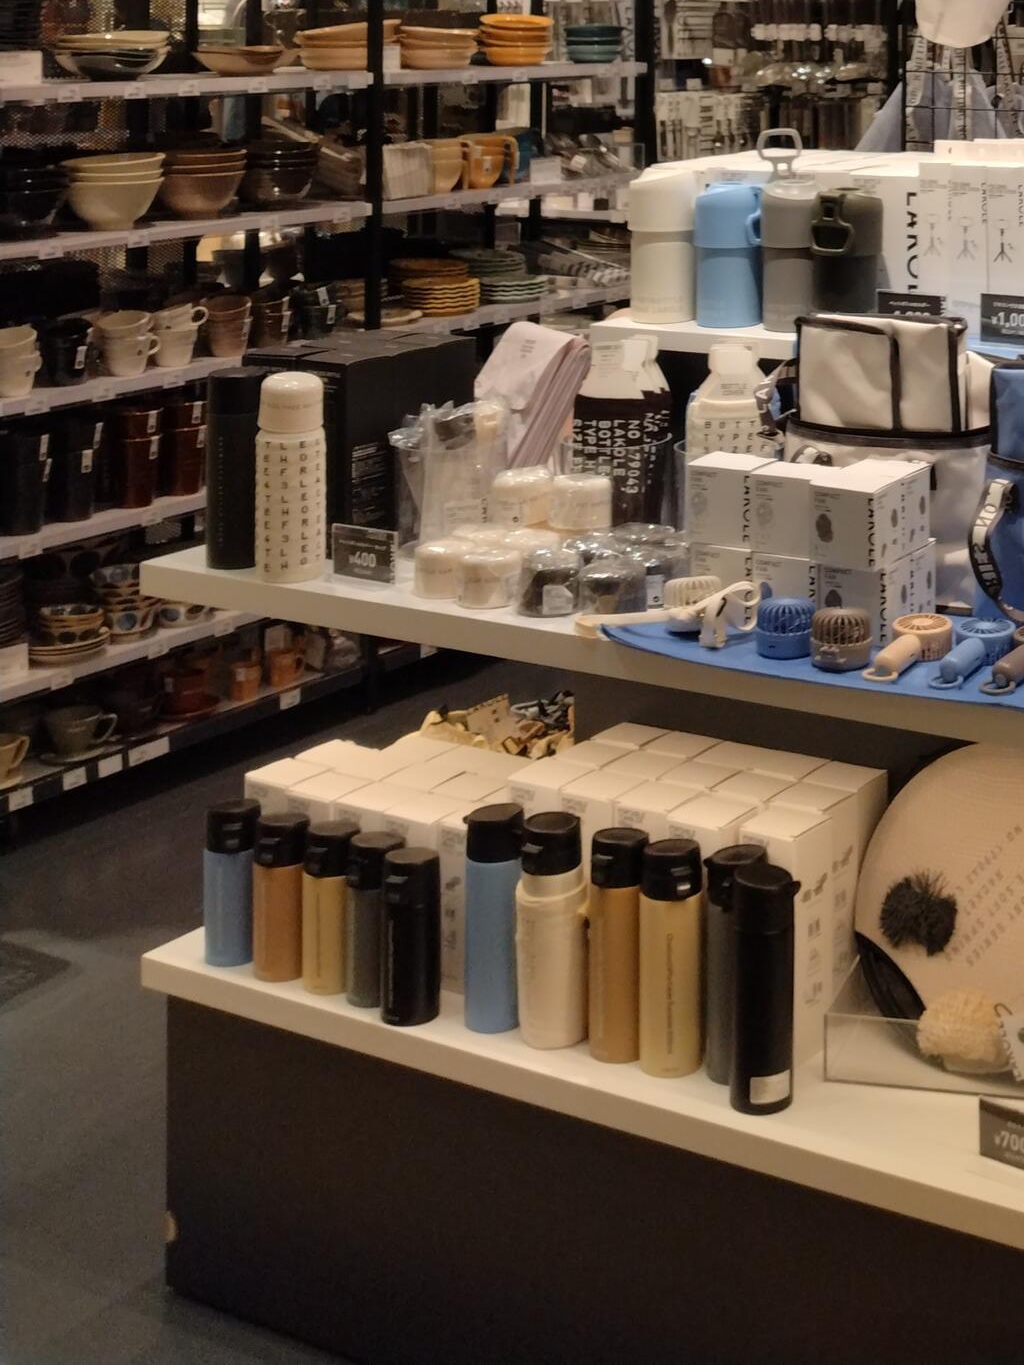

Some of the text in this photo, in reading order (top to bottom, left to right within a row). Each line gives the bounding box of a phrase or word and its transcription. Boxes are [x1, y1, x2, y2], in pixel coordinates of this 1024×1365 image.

[584, 420, 597, 454] TYPE
[598, 420, 611, 474] BOTTLE
[613, 419, 626, 476] LAKOLE
[348, 551, 377, 568] ¥400
